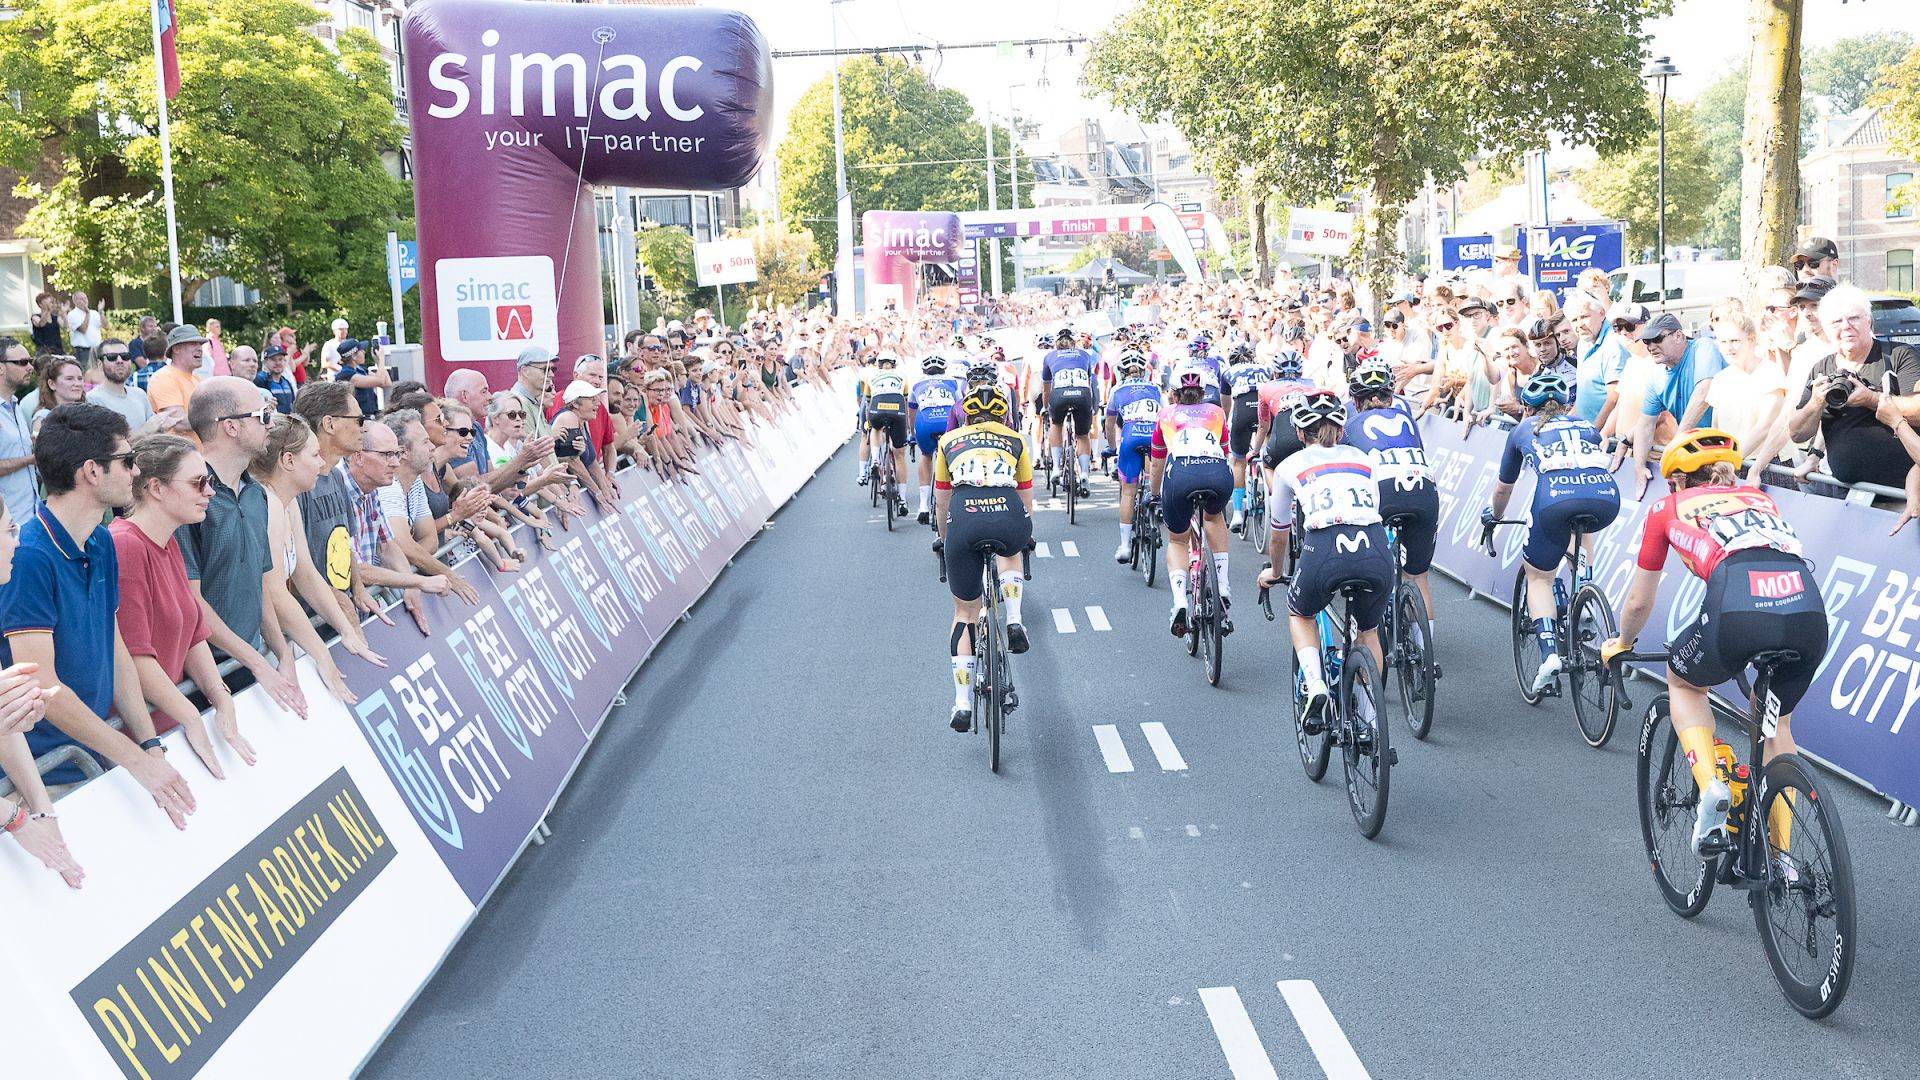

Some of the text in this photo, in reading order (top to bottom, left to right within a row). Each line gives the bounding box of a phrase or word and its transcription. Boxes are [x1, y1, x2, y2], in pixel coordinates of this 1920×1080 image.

[427, 29, 705, 122] simac
[484, 125, 705, 154] your IT-partner
[868, 221, 945, 248] simac
[1061, 219, 1096, 232] finish
[884, 249, 901, 257] your
[456, 276, 531, 302] simac
[950, 432, 1012, 448] JUMBO
[971, 440, 1013, 454] VISMA
[1132, 424, 1154, 432] ALUL
[1179, 430, 1216, 444] 4 4
[1379, 449, 1429, 467] 11 11
[1438, 450, 1475, 492] BET
[1549, 473, 1612, 488] youfone
[633, 495, 664, 537] BET
[964, 496, 1006, 506] JUMBO
[980, 504, 1009, 513] VISMA
[1310, 488, 1374, 515] 13 13
[599, 512, 636, 560] BET
[682, 511, 711, 551] CITY
[560, 536, 600, 591] BET
[658, 530, 690, 574] CITY
[624, 552, 662, 602] CITY
[1757, 571, 1801, 597] MOT
[517, 566, 563, 629] BET
[590, 579, 630, 637] CITY
[464, 604, 518, 678] BET
[551, 614, 597, 681] CITY
[1679, 629, 1702, 661] REITAN
[389, 652, 464, 746] BET
[505, 658, 558, 737] CITY
[1830, 643, 1920, 735] CITY
[1767, 697, 1780, 731] 114
[439, 714, 511, 814] CITY
[93, 788, 385, 1080] PLINTENFABRIEK.NL
[1820, 929, 1842, 1002] SWISS DT
